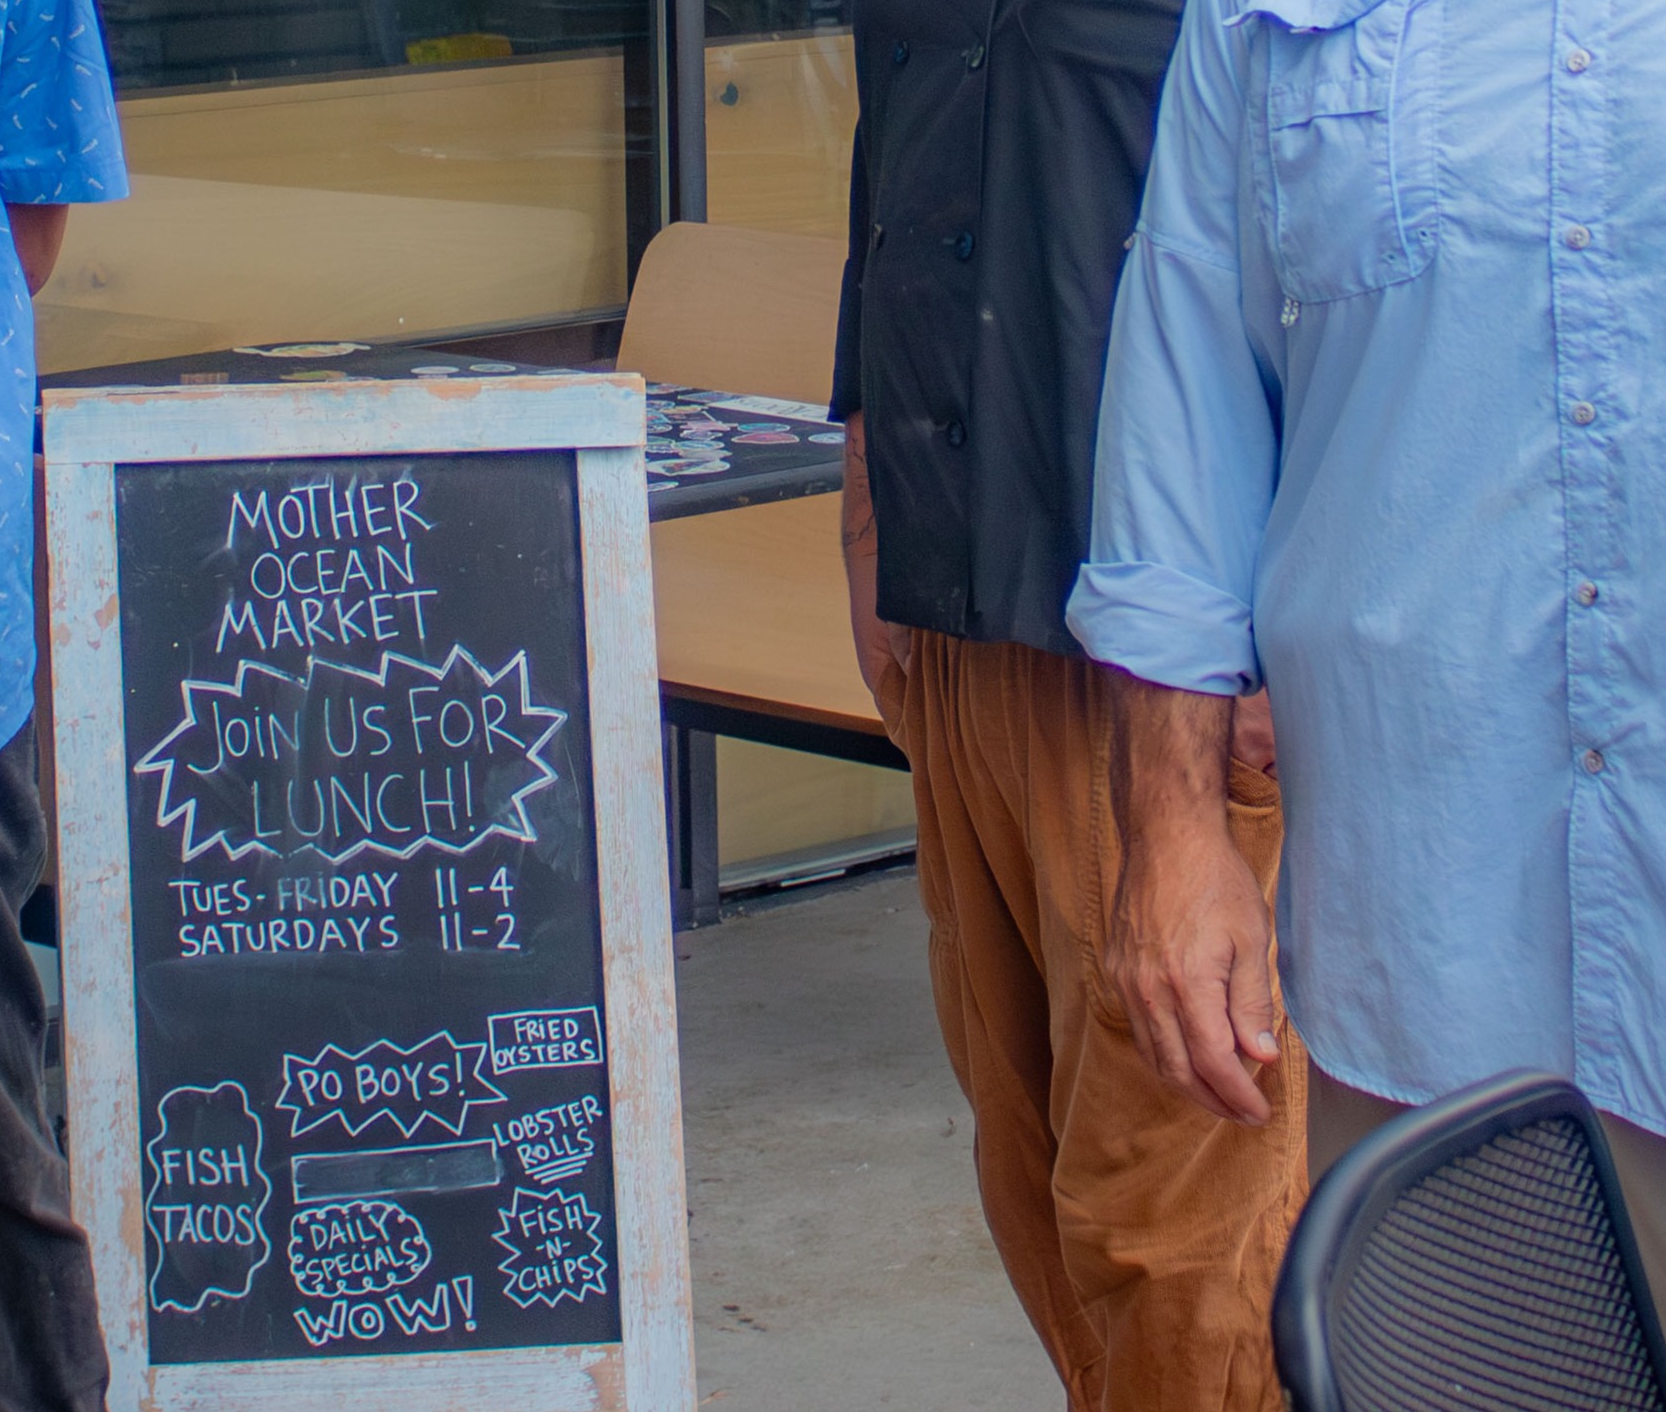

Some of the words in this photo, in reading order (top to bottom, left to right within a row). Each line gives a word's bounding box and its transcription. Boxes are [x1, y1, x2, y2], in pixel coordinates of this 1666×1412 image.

[227, 481, 432, 549] MOTHER
[251, 543, 414, 600] OCEAN
[217, 590, 437, 653] MARKET
[324, 696, 392, 756] US
[409, 687, 525, 753] FOR
[252, 760, 475, 838] LUNCH!
[434, 867, 513, 909] 11-4
[179, 915, 399, 957] SATURDAYS
[440, 913, 520, 951] 11-2
[299, 1069, 342, 1106] PO
[357, 1052, 465, 1102] BOYS!
[495, 1042, 595, 1067] OYSTERS
[494, 1095, 602, 1148] LOBSTER
[163, 1145, 249, 1186] FISH
[517, 1128, 594, 1170] ROLLS
[153, 1203, 256, 1245] TACOS
[293, 1275, 476, 1346] WOW!
